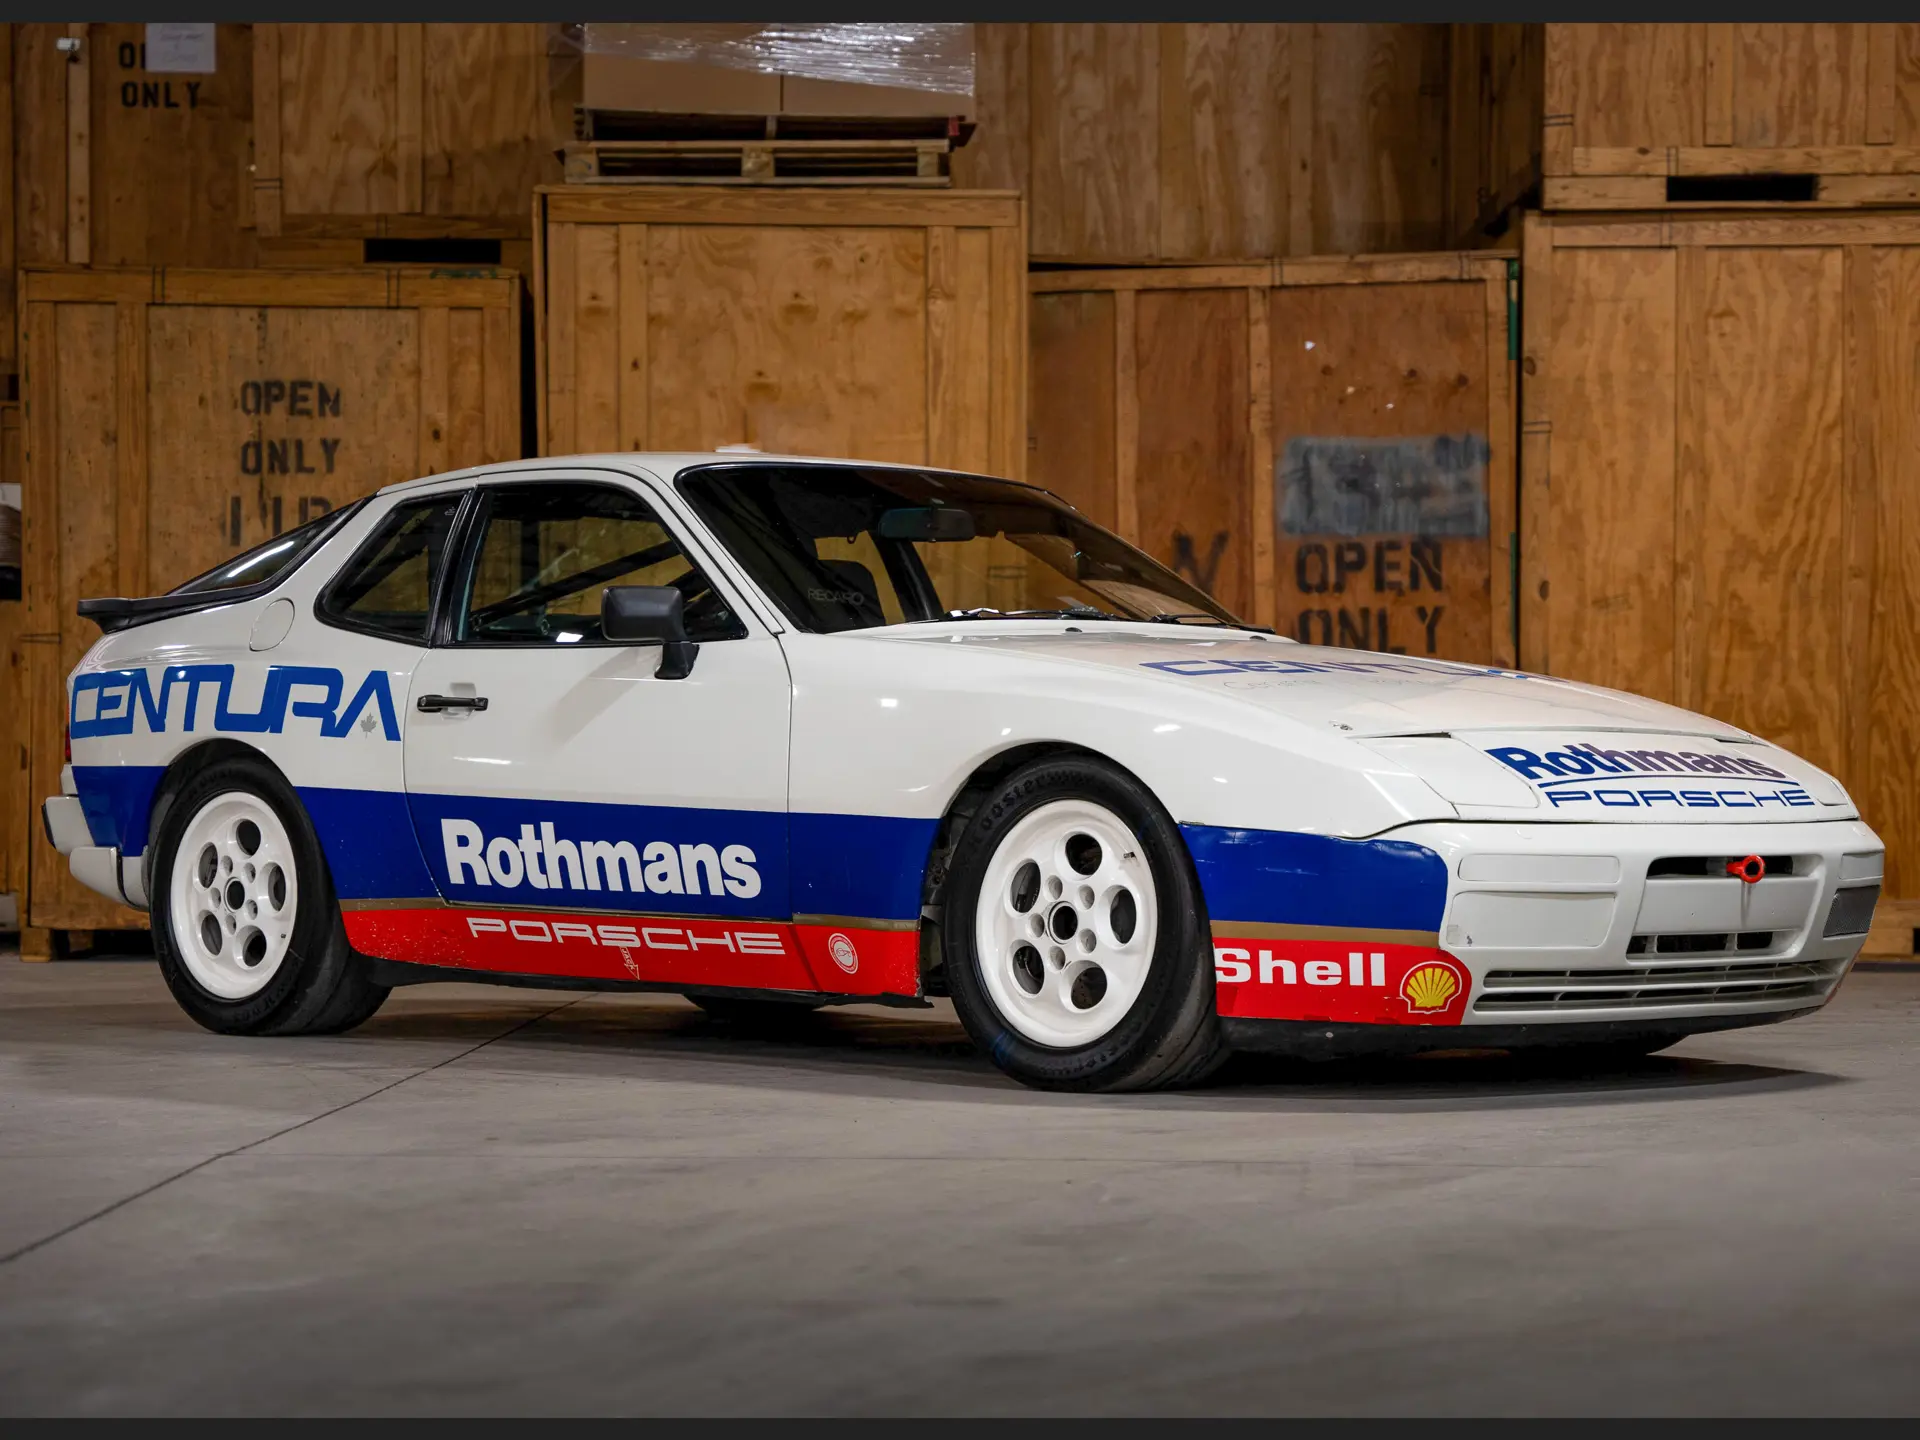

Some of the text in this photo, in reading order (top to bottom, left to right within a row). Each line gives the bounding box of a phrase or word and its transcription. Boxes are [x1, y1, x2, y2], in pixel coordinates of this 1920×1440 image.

[122, 81, 201, 109] ONLY
[241, 380, 341, 417] OPEN
[241, 437, 341, 475] ONLY
[1295, 540, 1443, 594] OPEN
[1298, 606, 1445, 655] ONLY
[70, 664, 402, 742] CENTURA
[1484, 743, 1787, 780] Rothmans
[1545, 789, 1816, 808] PORSCHE
[440, 818, 762, 899] Rothmans
[466, 917, 786, 955] PORSCHE
[1214, 947, 1386, 987] Shell
